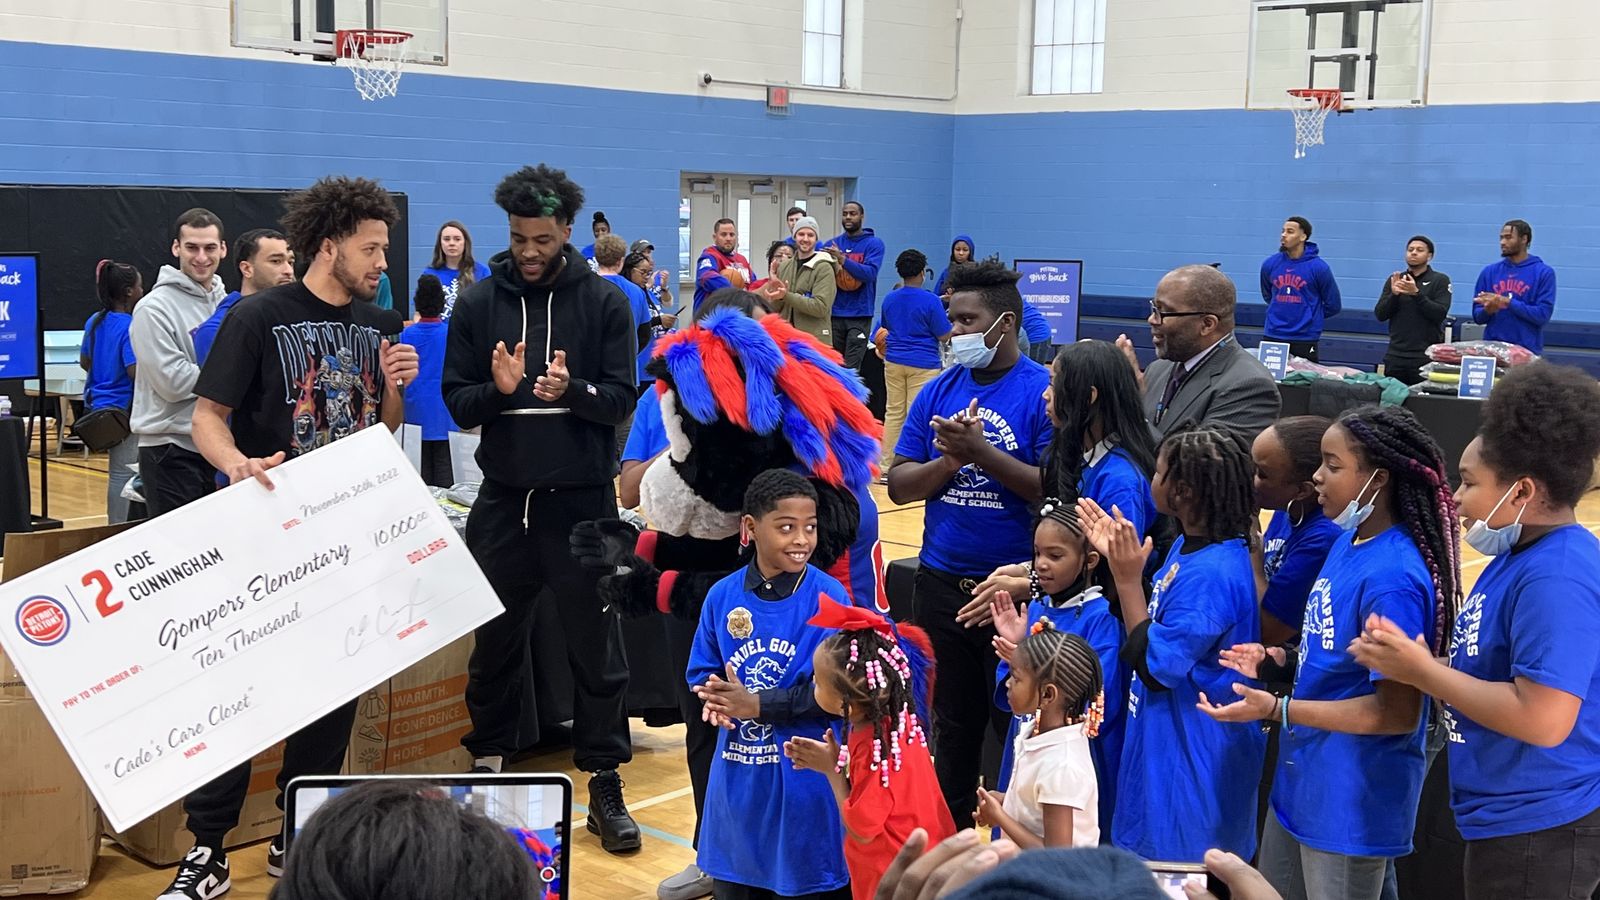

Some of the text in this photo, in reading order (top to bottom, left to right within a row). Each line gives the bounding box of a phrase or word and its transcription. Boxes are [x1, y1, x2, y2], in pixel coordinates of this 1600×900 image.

[0, 271, 21, 286] ack
[1029, 272, 1068, 283] give back
[1273, 273, 1307, 291] CRUISE
[1493, 279, 1530, 297] CRUISE
[977, 407, 1018, 451] GOMPERS
[300, 492, 350, 518] November
[968, 499, 1005, 509] SCHOOL
[114, 550, 156, 578] CADE
[128, 547, 224, 601] CUNNINGHAM
[81, 569, 123, 618] 2
[158, 544, 351, 650] Gompers Elementary
[192, 645, 225, 669] Ten
[225, 602, 302, 652] Thousand
[63, 697, 79, 709] PAY
[79, 689, 92, 700] TO
[90, 681, 106, 694] THE
[106, 671, 132, 686] ORDER
[394, 685, 449, 708] WARMTH.
[393, 706, 463, 735] CONFIDENCE.
[167, 722, 205, 749] Care
[183, 742, 208, 759] MEMO
[755, 754, 780, 765] SCHO
